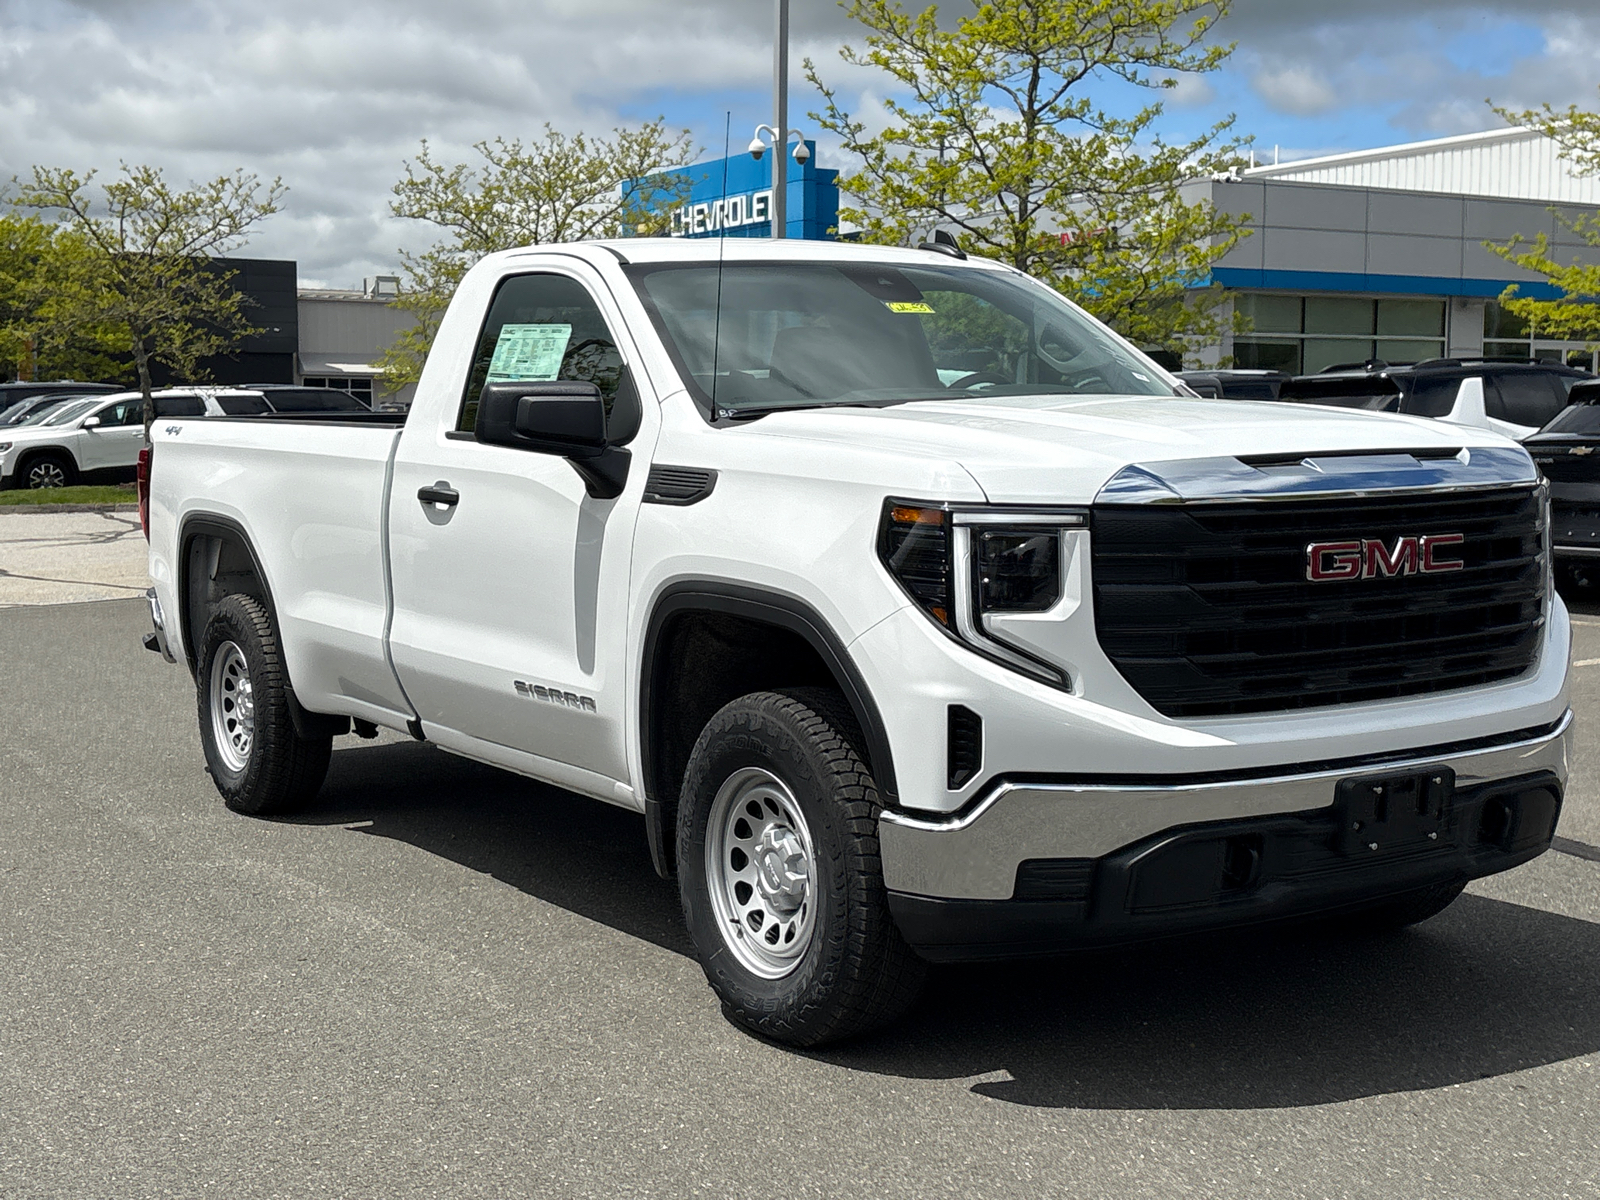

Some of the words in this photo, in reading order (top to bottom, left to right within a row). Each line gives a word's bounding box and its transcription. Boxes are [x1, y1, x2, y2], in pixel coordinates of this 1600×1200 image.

[670, 189, 773, 237] CHEVROLET
[1306, 533, 1464, 582] GMC
[513, 680, 597, 713] SIERRA
